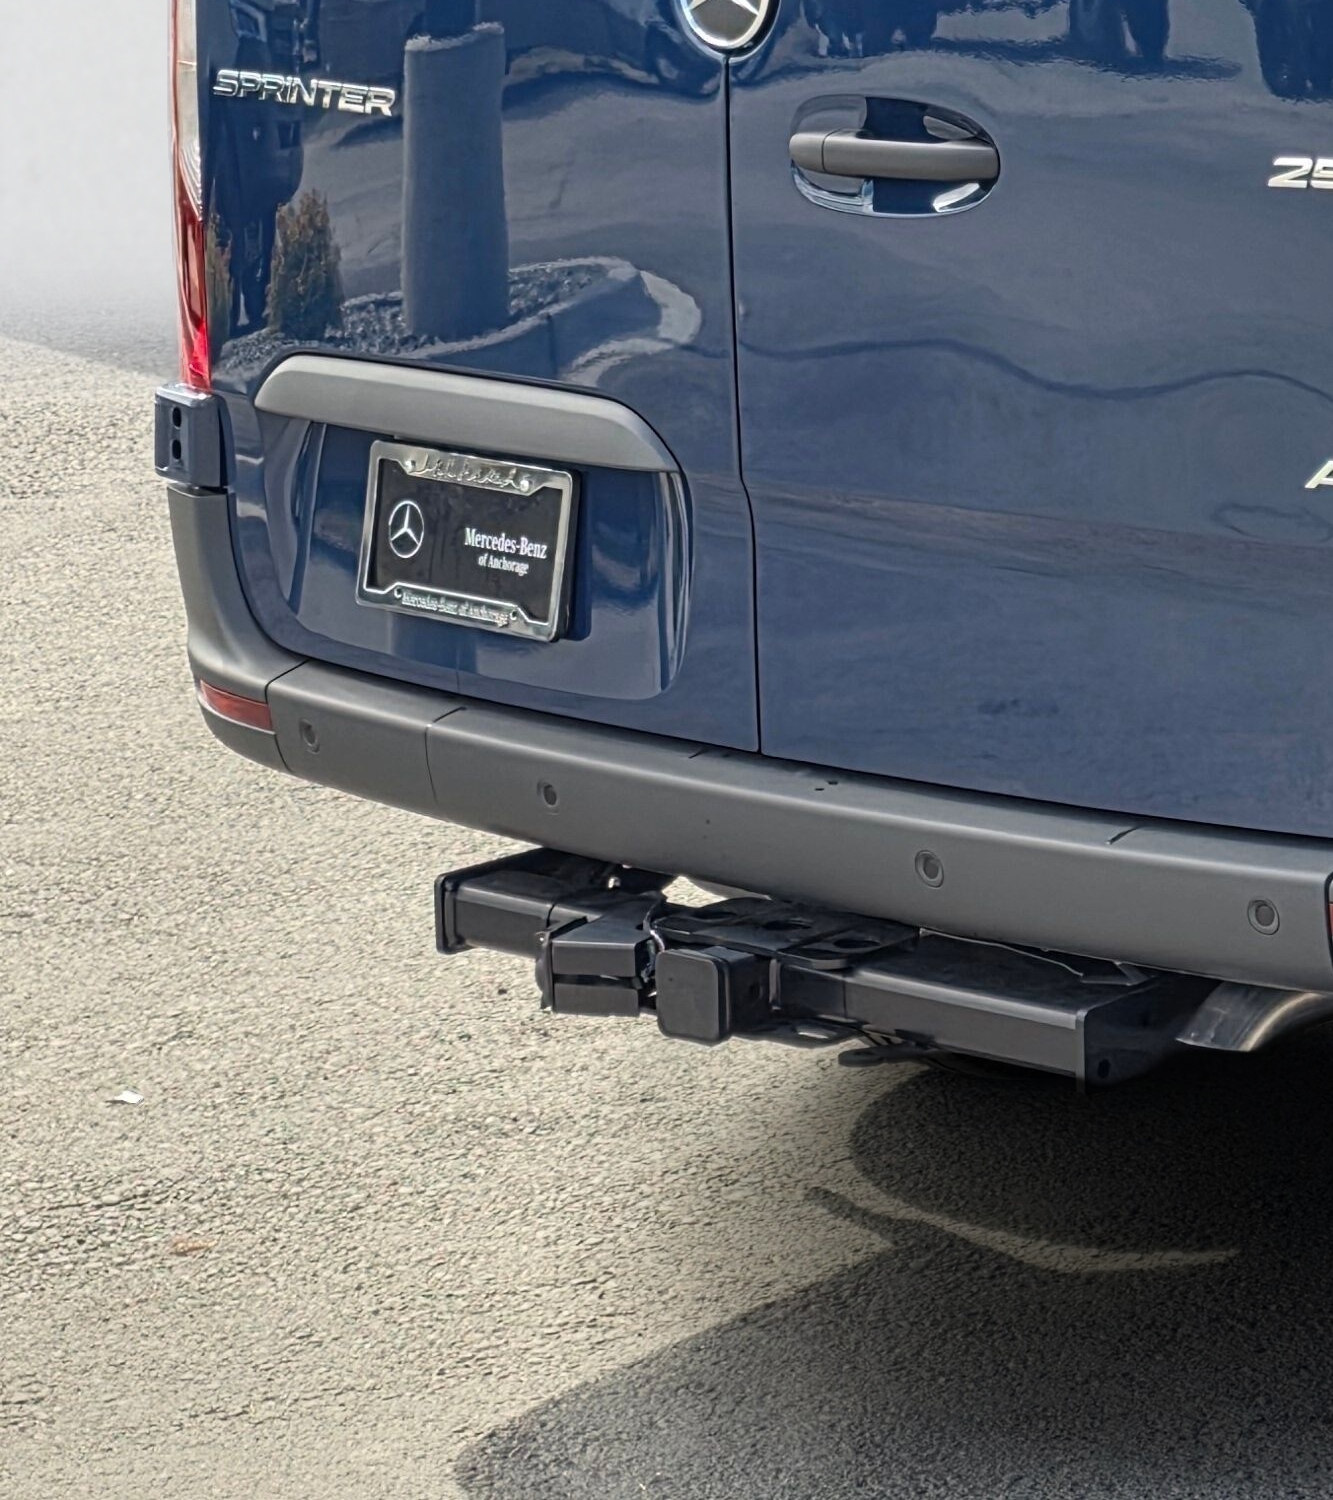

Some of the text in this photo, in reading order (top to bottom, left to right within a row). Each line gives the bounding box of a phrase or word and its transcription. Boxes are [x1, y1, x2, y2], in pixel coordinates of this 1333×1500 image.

[212, 69, 396, 117] SPRINTER
[464, 527, 548, 559] Mercedes-Benz
[487, 554, 530, 576] Anchorage
